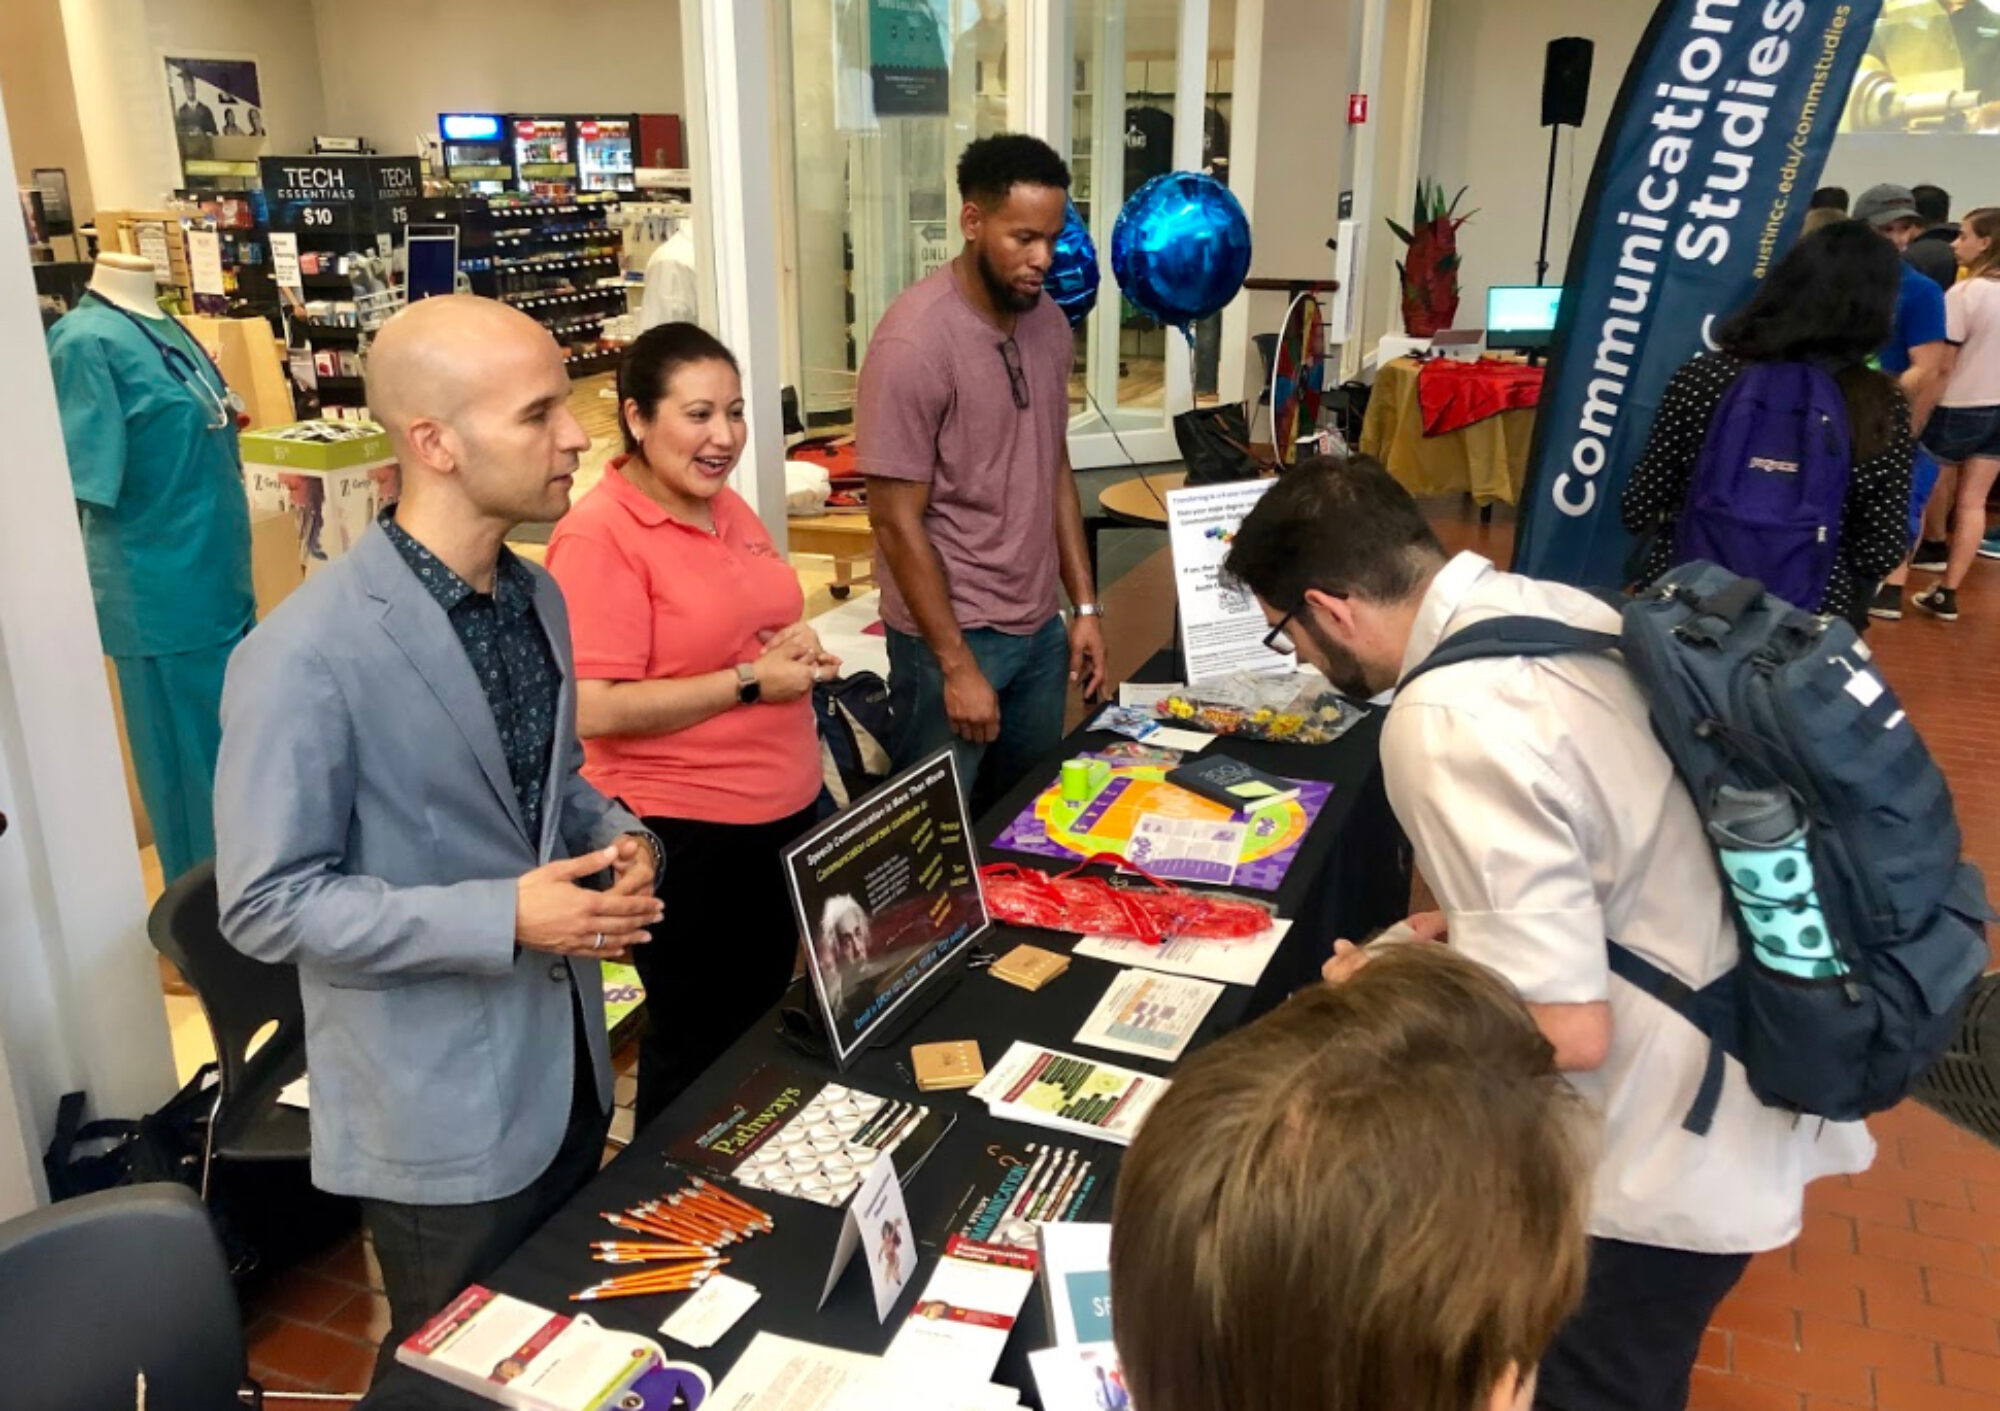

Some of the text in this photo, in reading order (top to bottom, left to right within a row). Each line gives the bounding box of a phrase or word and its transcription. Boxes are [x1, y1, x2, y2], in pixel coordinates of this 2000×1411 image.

[1676, 0, 1806, 264] Studies
[1753, 4, 1850, 279] austincc.edu/commstudies
[277, 189, 356, 200] ESSENTIALS
[282, 167, 345, 189] TECH
[380, 168, 414, 188] TECH
[303, 207, 333, 226] $10
[1553, 0, 1741, 518] Communication
[711, 1087, 801, 1155] Pathways
[970, 1155, 1031, 1242] MMUNICATION?
